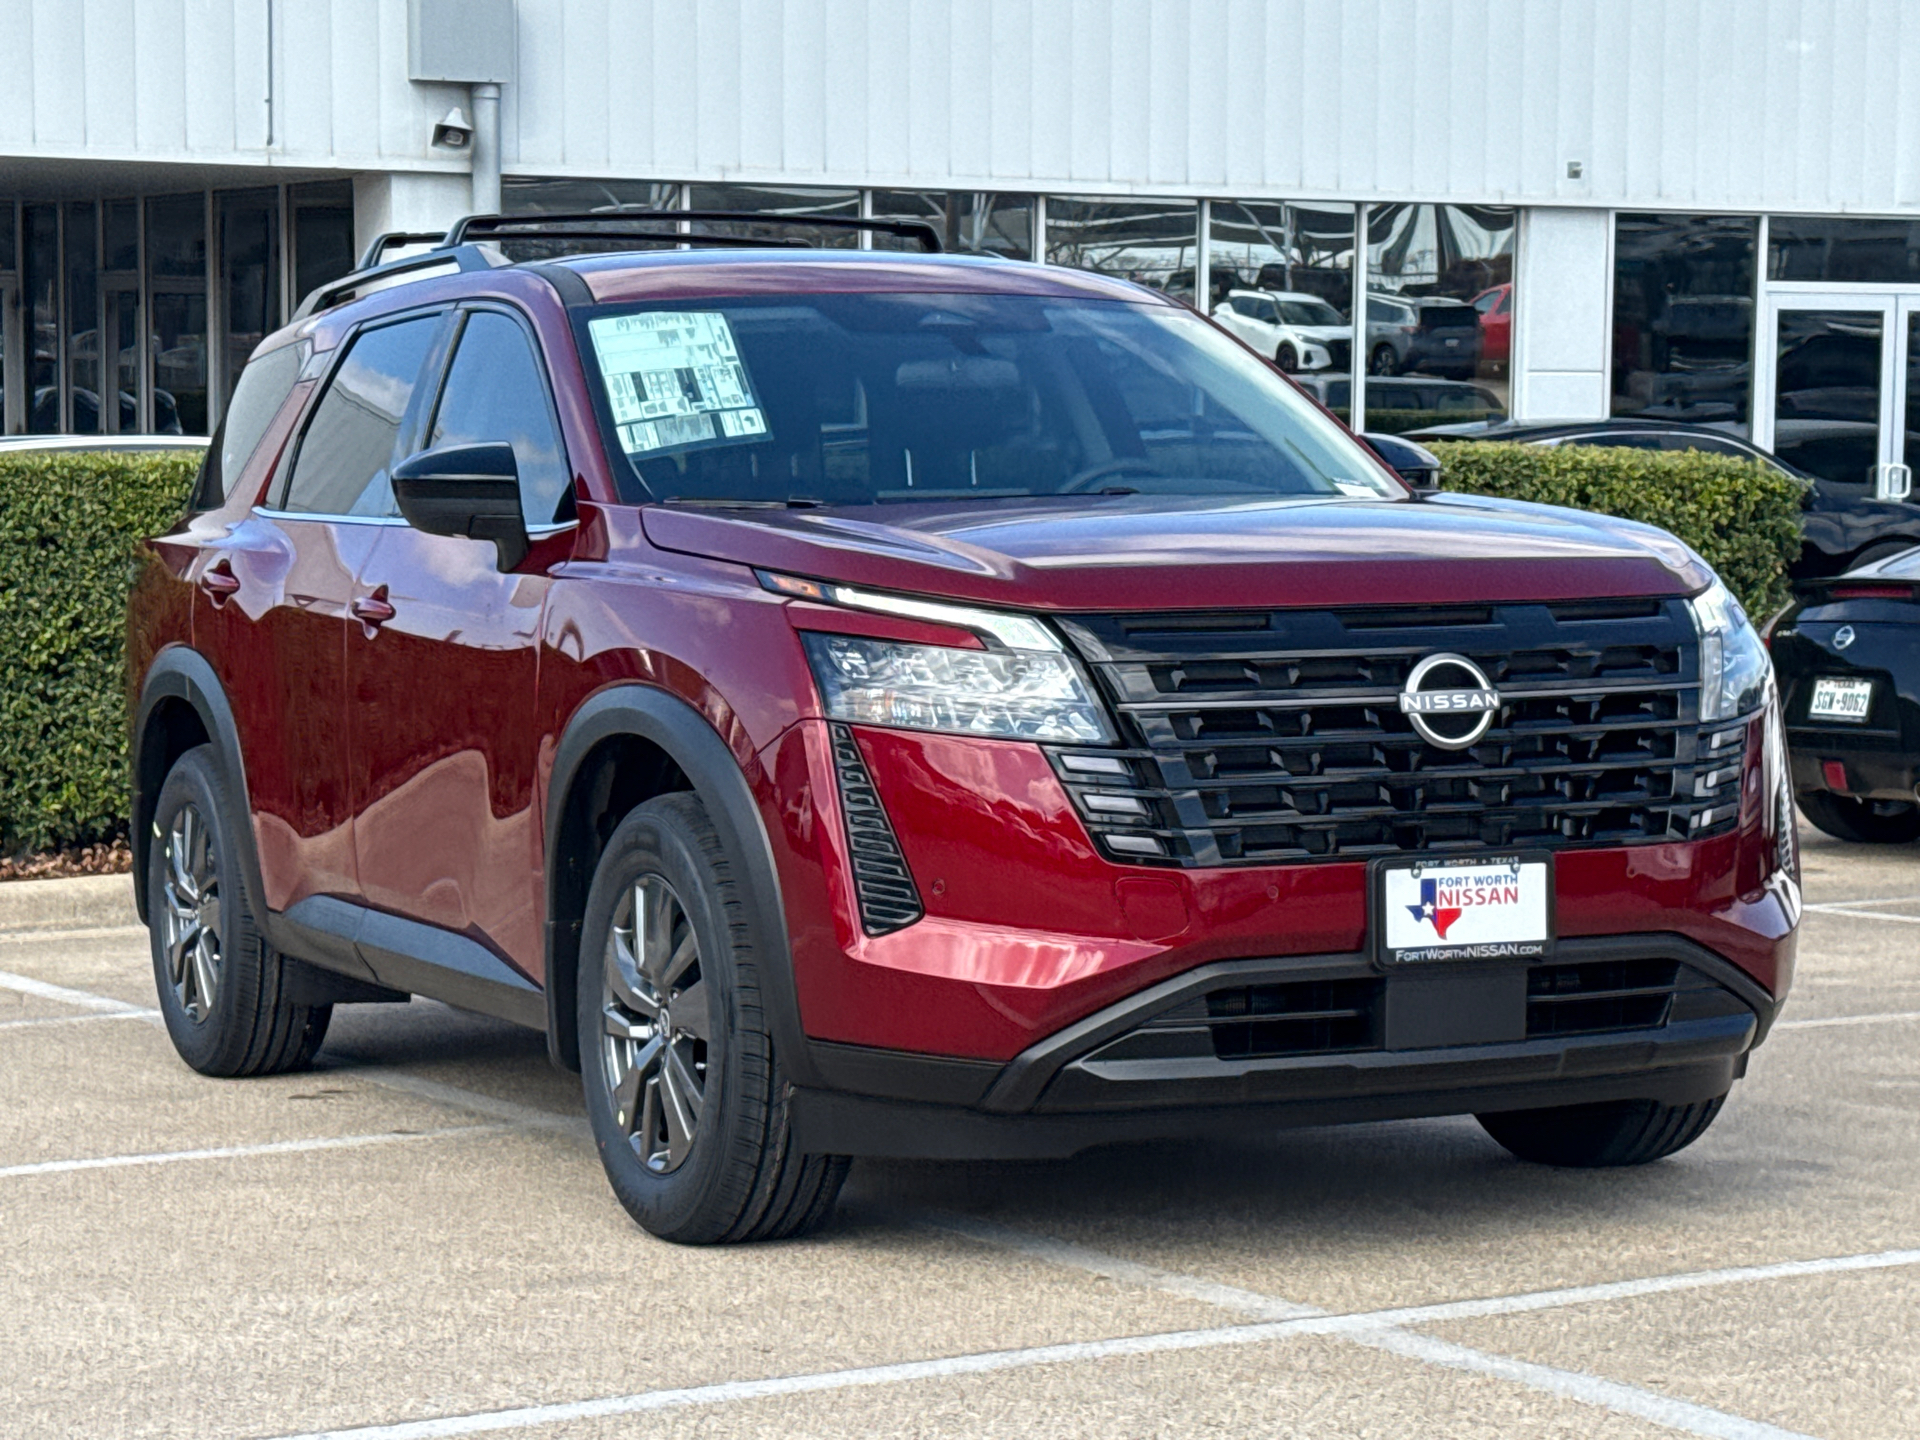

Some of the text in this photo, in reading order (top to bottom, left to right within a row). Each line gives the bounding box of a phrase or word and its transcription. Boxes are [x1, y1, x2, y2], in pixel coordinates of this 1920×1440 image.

[1403, 693, 1498, 710] NISSAN
[1444, 858, 1477, 867] WORTH
[1439, 874, 1518, 888] FORT WORTH
[1438, 886, 1519, 907] NISSAN
